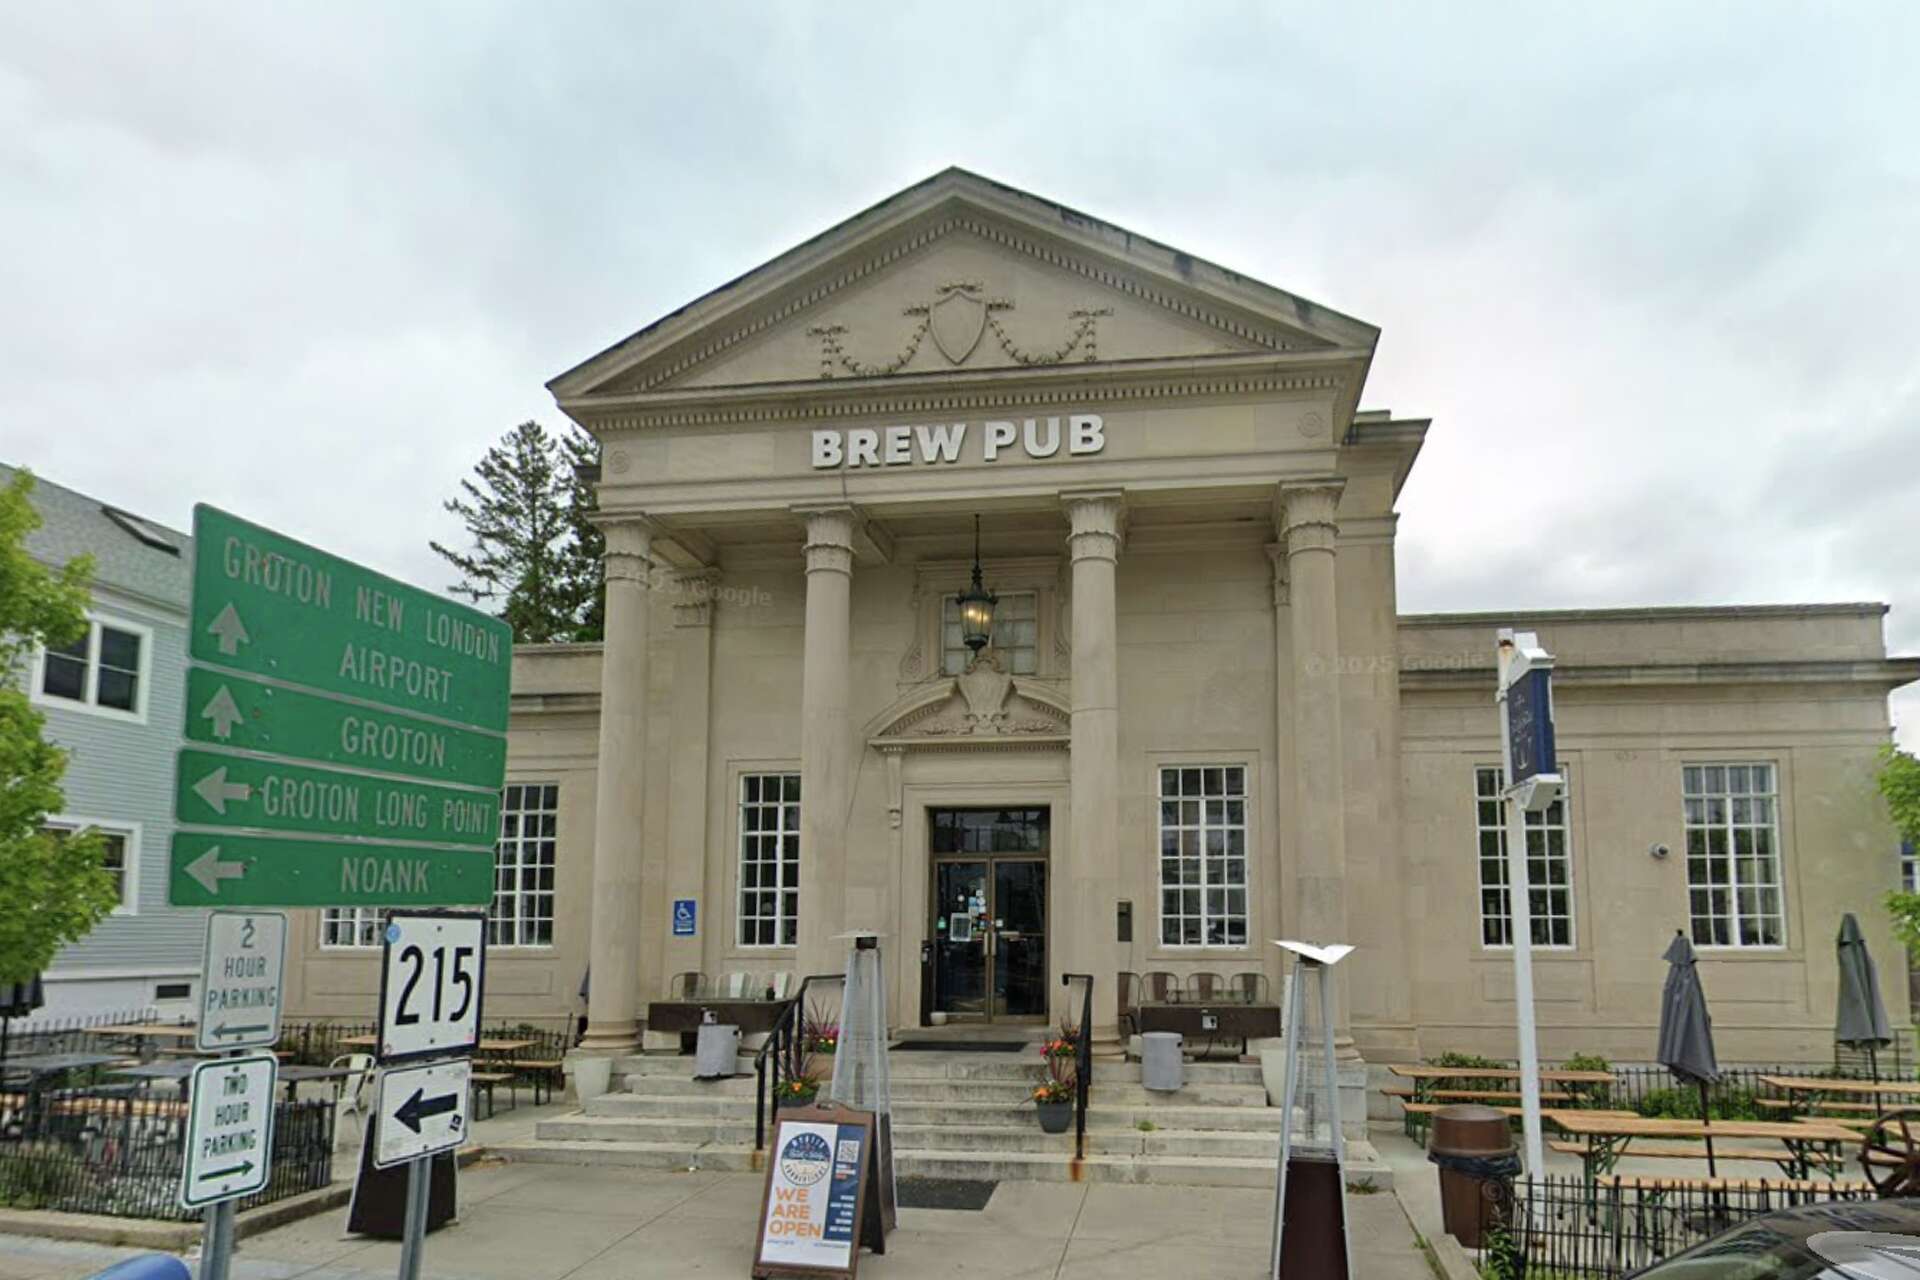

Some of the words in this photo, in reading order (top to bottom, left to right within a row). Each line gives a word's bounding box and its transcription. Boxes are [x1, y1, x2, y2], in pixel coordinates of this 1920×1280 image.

[812, 425, 966, 469] BREW
[984, 414, 1105, 461] PUB
[224, 536, 331, 609] GROTON
[356, 585, 403, 632] NEW
[426, 609, 499, 664] LONDON
[339, 642, 453, 704] AIRPORT
[342, 716, 445, 768] GROTON
[262, 775, 360, 823] GROTON
[375, 790, 428, 829] LONG
[442, 799, 491, 835] POINT
[341, 856, 430, 893] NOANK
[241, 922, 256, 949] 2
[224, 955, 266, 978] HOUR
[207, 985, 277, 1012] PARKING
[395, 944, 473, 1026] 215
[223, 1073, 248, 1096] TWO
[214, 1101, 249, 1126] HOUR
[203, 1129, 257, 1158] PARKING
[776, 1187, 809, 1202] WE
[773, 1204, 810, 1219] ARE
[769, 1220, 821, 1237] OPEN
